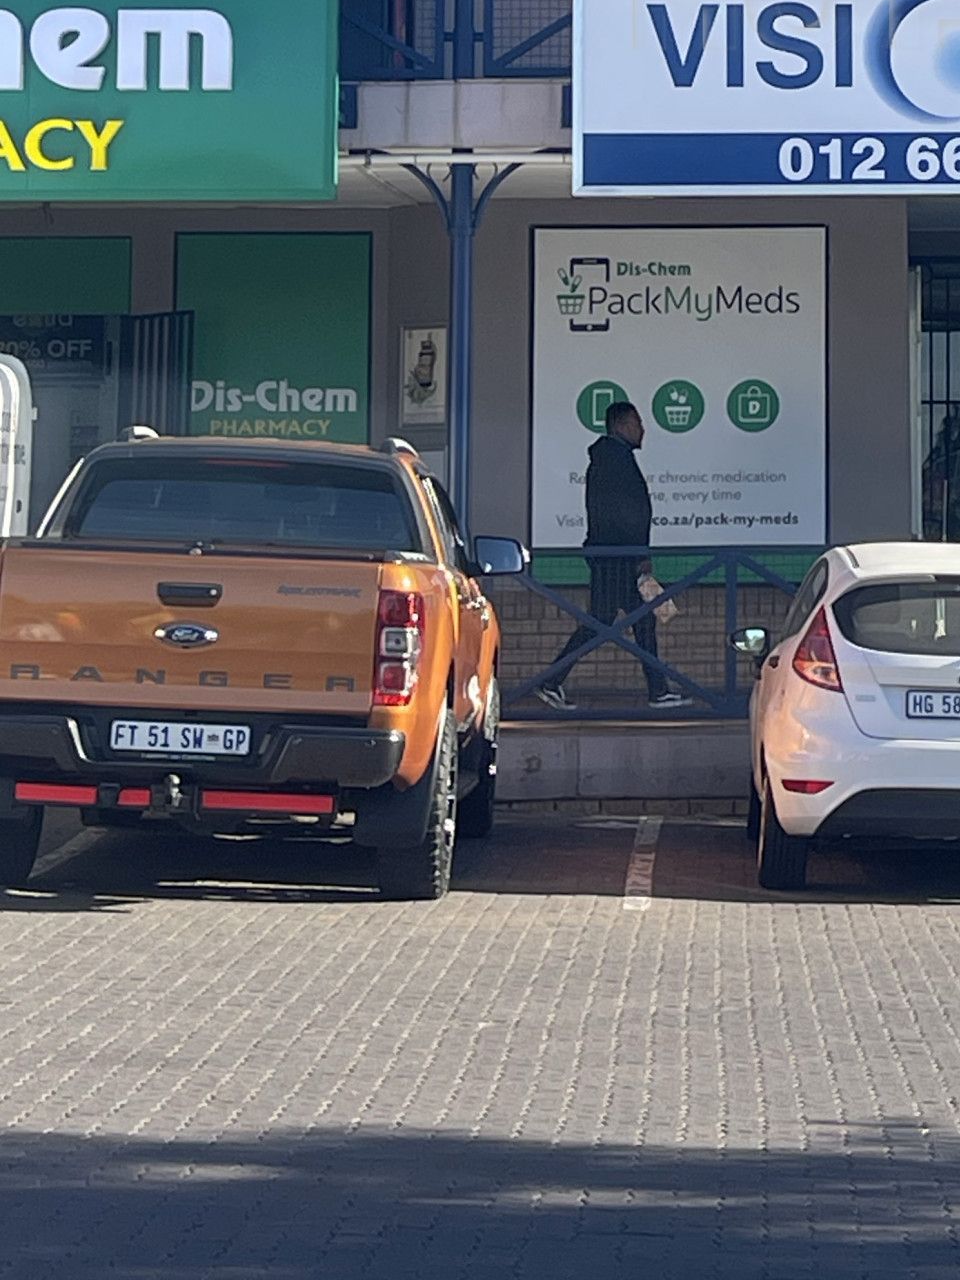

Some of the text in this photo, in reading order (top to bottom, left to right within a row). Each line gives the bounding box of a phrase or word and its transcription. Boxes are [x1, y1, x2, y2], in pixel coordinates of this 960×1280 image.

[777, 137, 886, 181] 012
[616, 261, 692, 277] Dis-Chem
[587, 285, 801, 322] PackMyMeds
[47, 339, 92, 358] OFF
[190, 378, 357, 412] Dis-Chem
[209, 419, 333, 436] PHARMACY
[658, 472, 708, 484] chronic
[711, 471, 787, 483] medication
[671, 492, 708, 503] every
[712, 490, 742, 501] time
[651, 512, 799, 530] co.za/pack-my-meds
[10, 663, 355, 692] RANGER
[912, 694, 933, 713] HG
[114, 723, 247, 752] FT 51 SW GP
